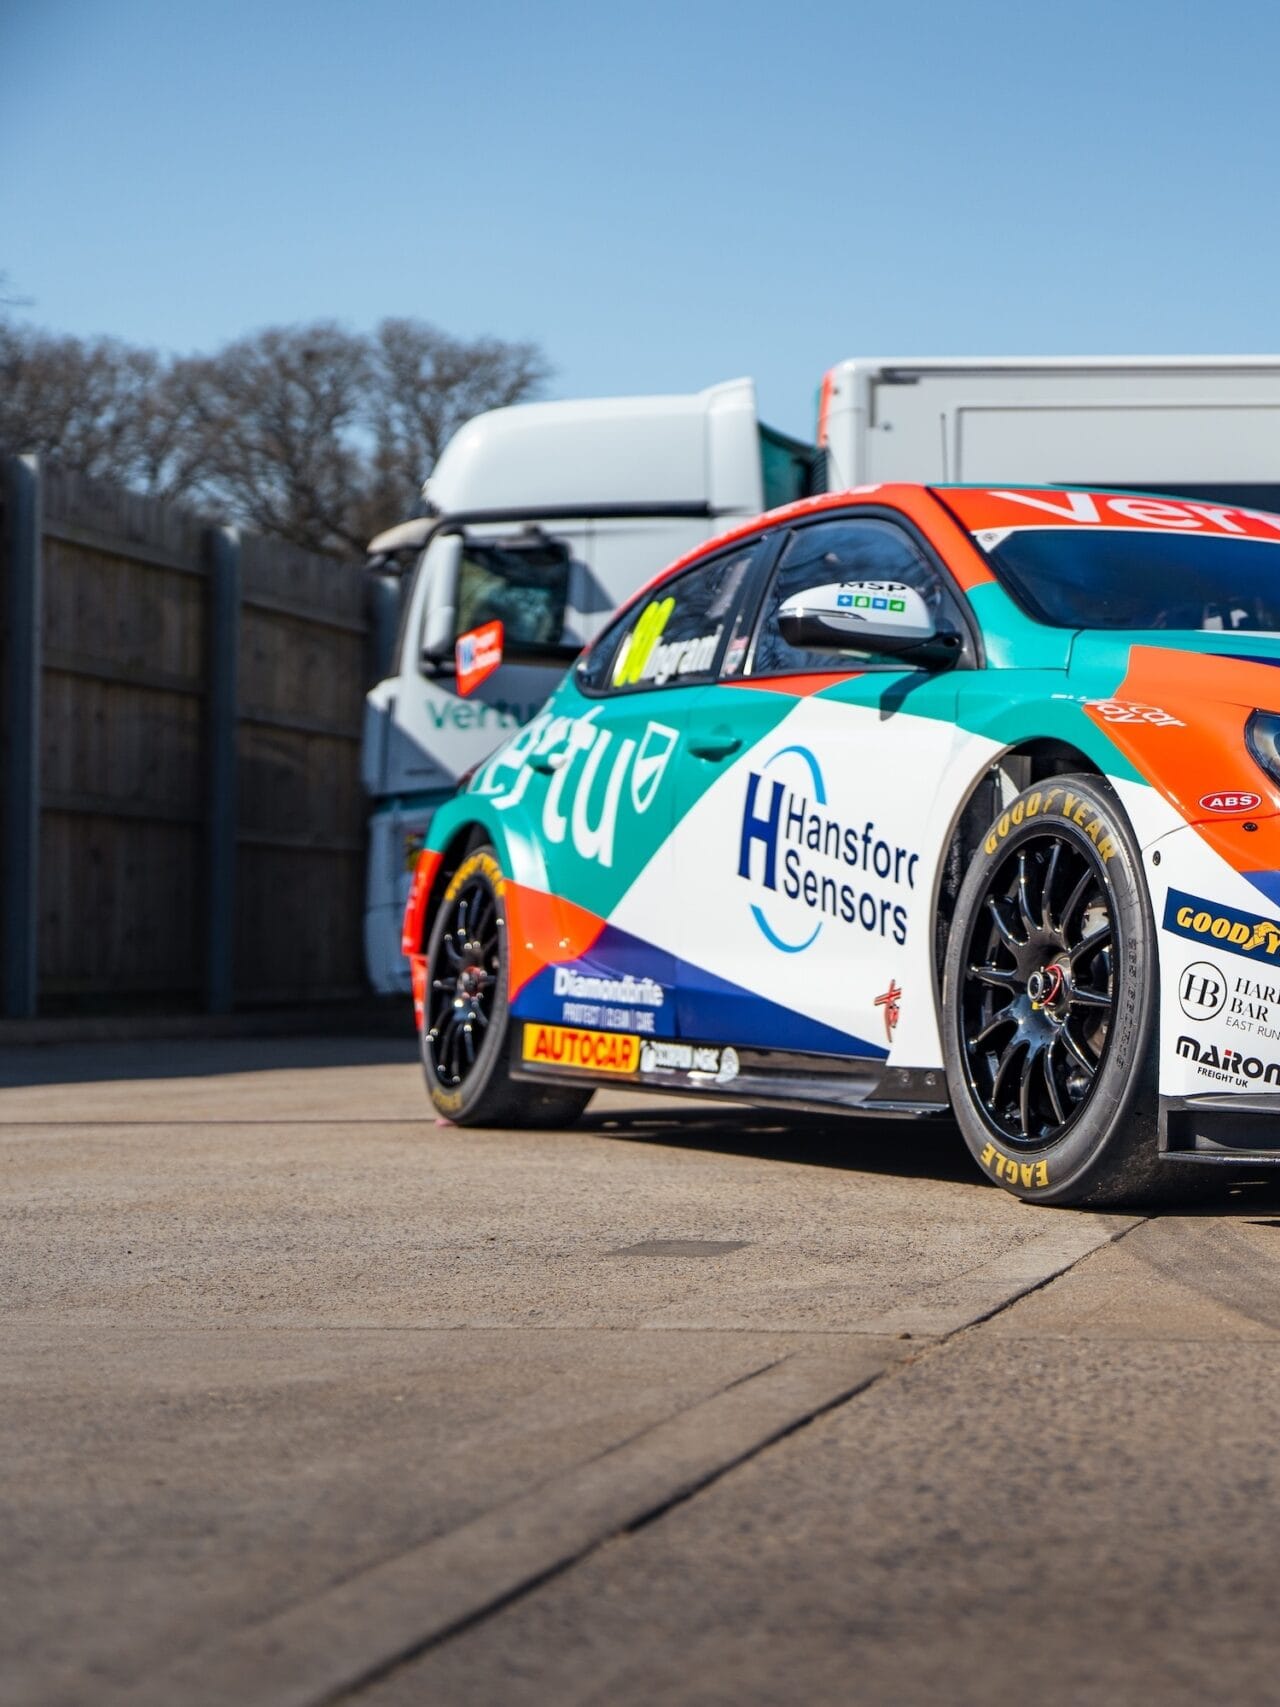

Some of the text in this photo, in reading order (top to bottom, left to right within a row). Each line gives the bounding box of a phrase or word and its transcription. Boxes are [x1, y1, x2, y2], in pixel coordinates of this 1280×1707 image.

[466, 704, 637, 868] ertu
[1210, 792, 1253, 808] ABS
[783, 848, 908, 946] Sensors
[1226, 1016, 1254, 1032] EAST
[1230, 997, 1270, 1023] BAR
[534, 1028, 634, 1069] AUTOCAR
[1197, 1066, 1249, 1089] FREIGHT UK
[981, 1142, 1049, 1188] EAGLE
